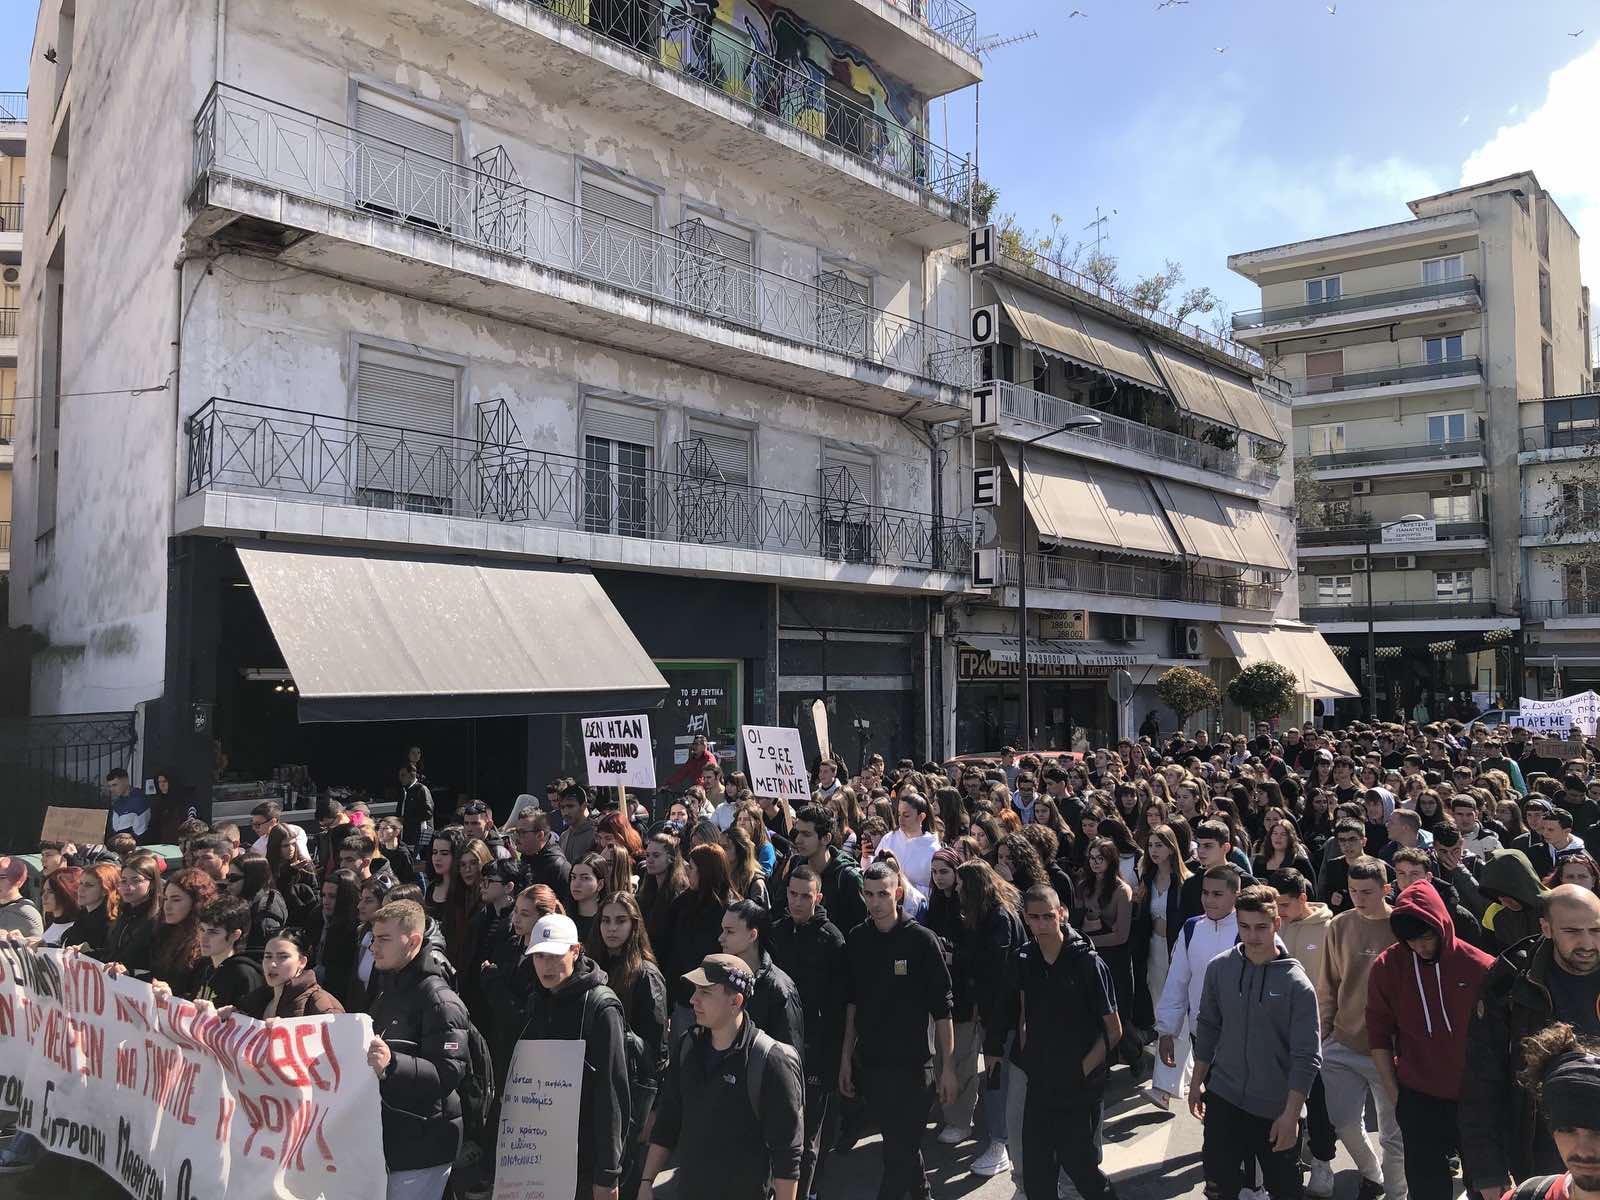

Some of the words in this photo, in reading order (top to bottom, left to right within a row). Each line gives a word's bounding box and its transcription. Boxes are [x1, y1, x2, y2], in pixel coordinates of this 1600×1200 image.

[971, 229, 994, 585] HOTEL
[585, 720, 604, 739] ΔΕΝ
[609, 719, 643, 739] ΗΤΑΝ
[1516, 716, 1546, 728] ΠΑΡΕ
[1550, 716, 1565, 727] ΜΕ
[748, 728, 762, 744] ΟΙ
[589, 742, 639, 758] ΑΝΘΡΩΠΙΝΟ
[758, 747, 792, 763] ΖΩΕΣ
[598, 759, 628, 774] ΛΑΘΟΣ
[775, 763, 795, 776] ΜΑΣ
[755, 777, 806, 795] ΜΕΤΡΑΝΕ
